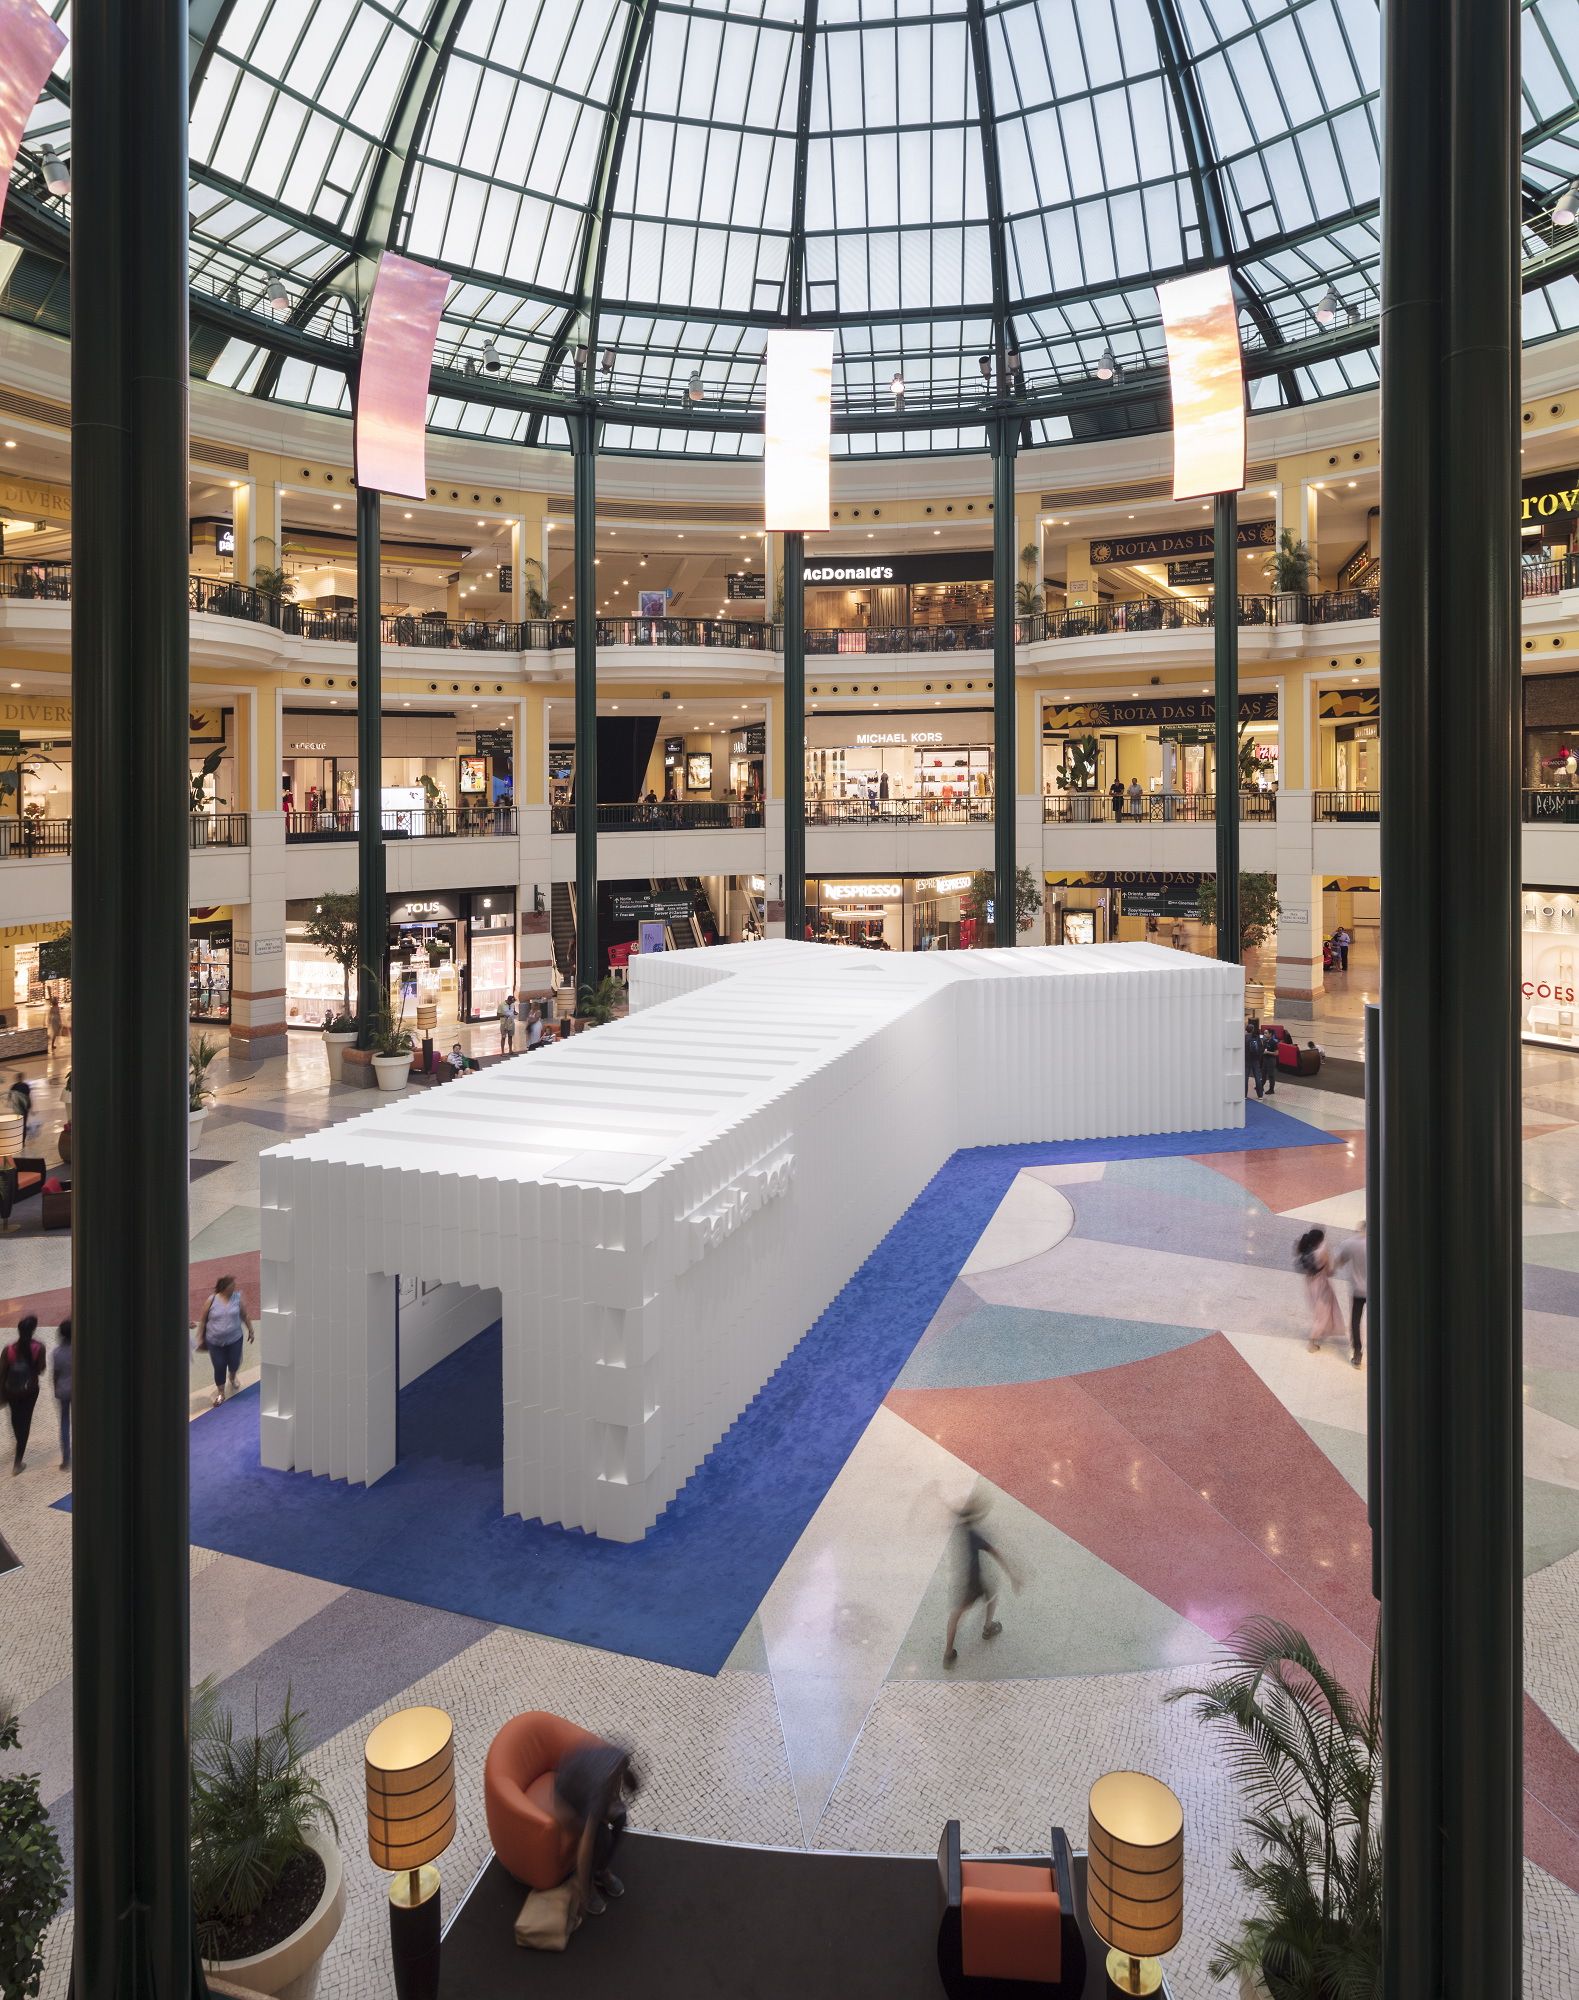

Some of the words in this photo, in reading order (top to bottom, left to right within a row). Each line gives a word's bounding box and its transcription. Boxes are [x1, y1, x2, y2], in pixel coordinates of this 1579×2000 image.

[1115, 541, 1157, 556] ROTA
[1162, 537, 1193, 550] DAS
[1199, 529, 1256, 547] ÍNAS
[803, 566, 893, 581] McDonald's
[1113, 707, 1157, 720] ROTA
[1162, 705, 1195, 718] DAS
[1200, 701, 1261, 717] ÍNAS
[857, 733, 907, 743] MICHAEL
[911, 732, 943, 742] KORS
[1113, 871, 1157, 883] ROTA
[1163, 872, 1195, 883] DAS
[823, 884, 901, 899] NESPRESSO
[405, 902, 440, 913] TOUS
[4, 920, 72, 938] DIVER
[215, 937, 230, 945] TOUS
[1521, 981, 1575, 1002] ÇÕES
[689, 1187, 753, 1261] Paula
